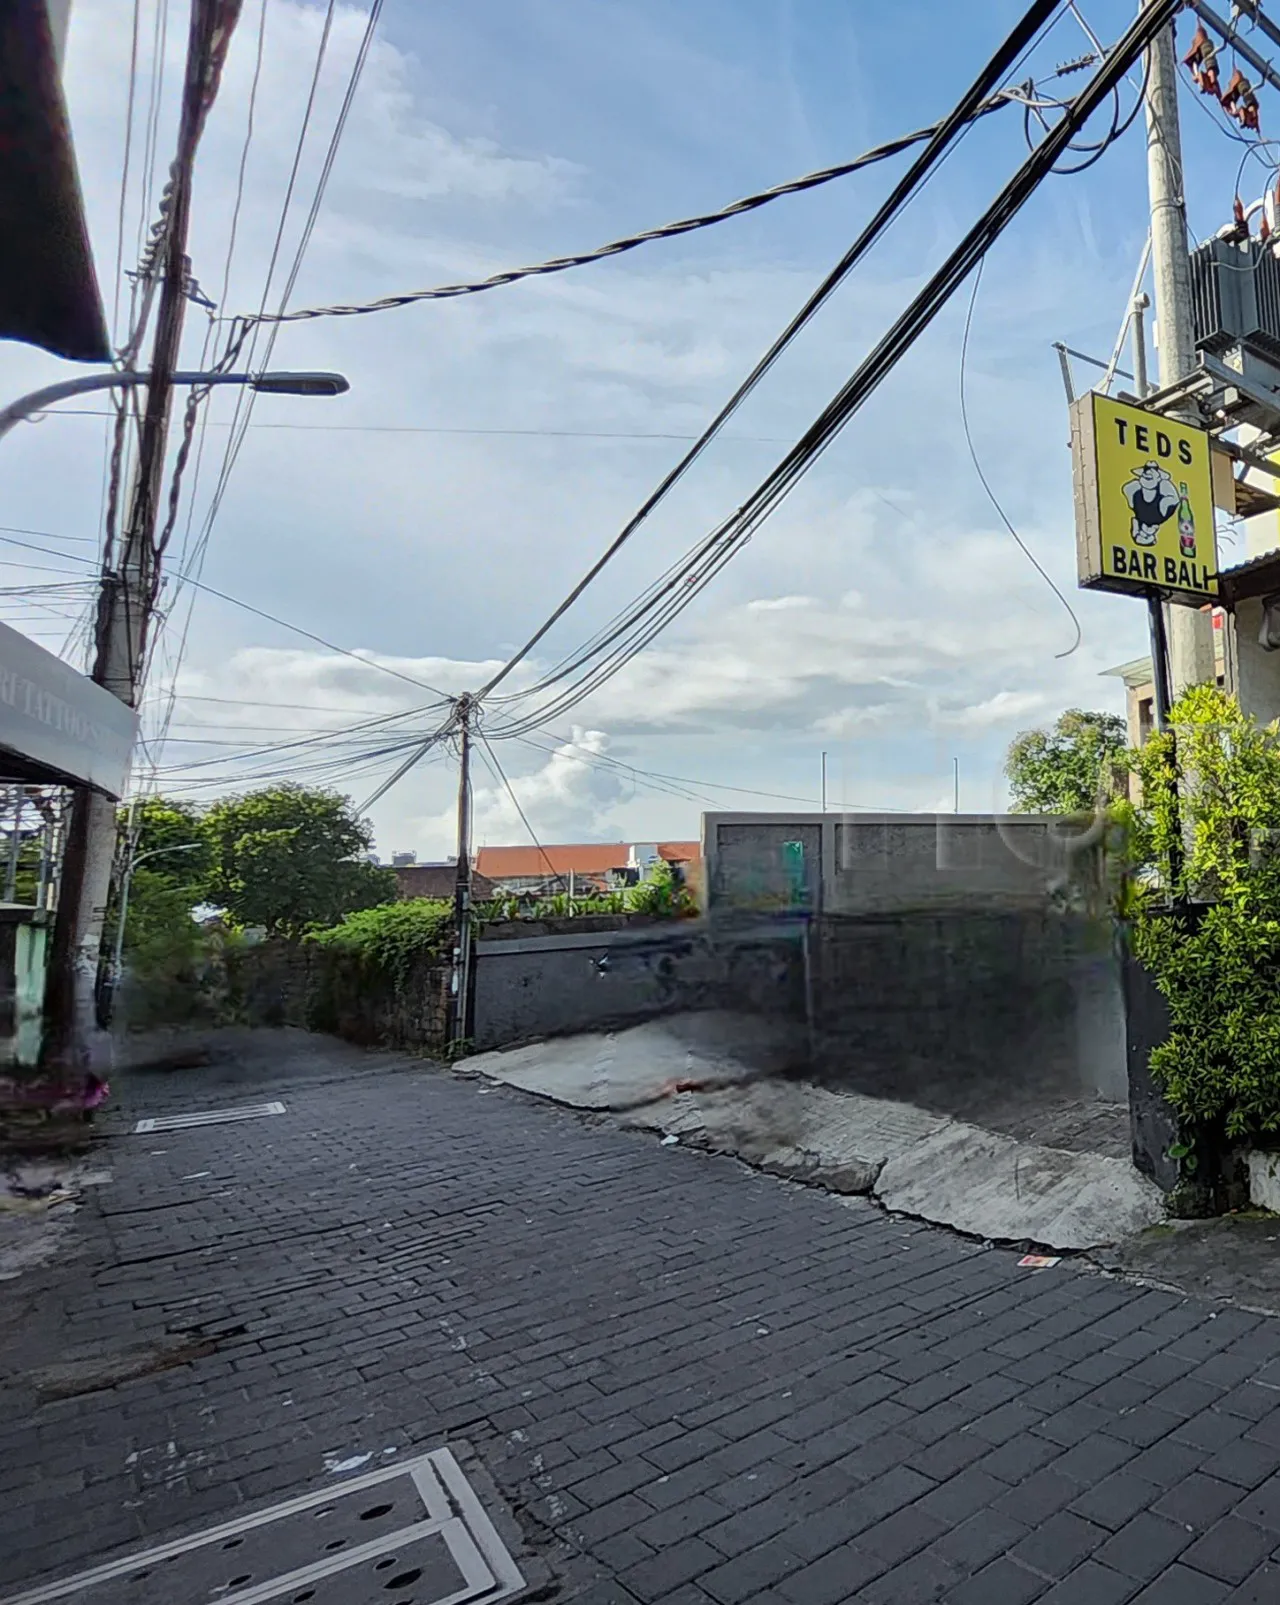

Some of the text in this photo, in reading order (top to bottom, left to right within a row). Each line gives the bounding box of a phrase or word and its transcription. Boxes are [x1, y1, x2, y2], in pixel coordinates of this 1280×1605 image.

[1114, 417, 1193, 466] TEDS
[1112, 545, 1209, 591] BAR BALI
